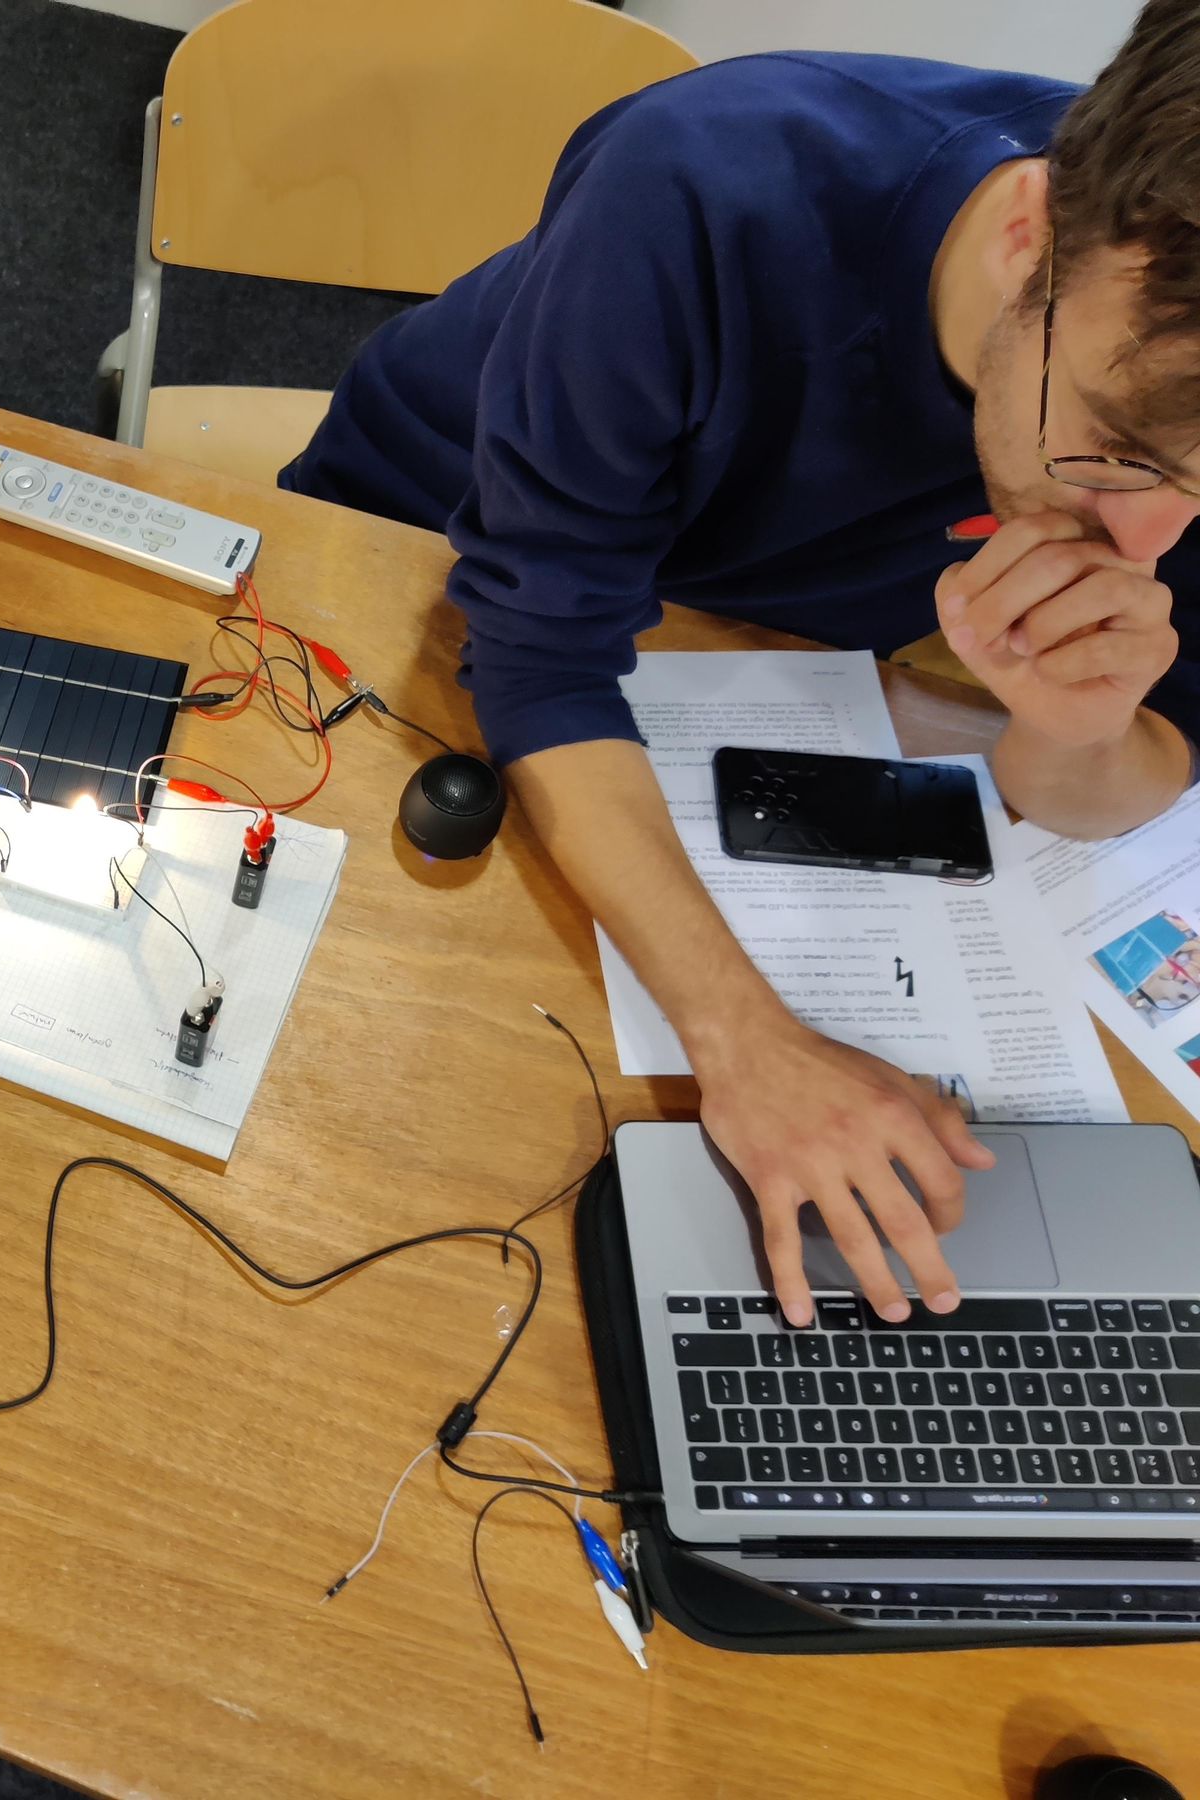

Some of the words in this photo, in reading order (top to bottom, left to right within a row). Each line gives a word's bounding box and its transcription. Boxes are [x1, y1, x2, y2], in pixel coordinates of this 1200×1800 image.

[213, 536, 230, 562] SONY
[883, 1346, 896, 1356] M
[921, 1346, 932, 1356] N
[998, 1346, 1007, 1356] V
[1034, 1346, 1045, 1357] C
[1072, 1347, 1082, 1357] X
[1110, 1346, 1120, 1358] Z
[836, 1382, 845, 1393] L
[873, 1383, 883, 1393] K
[911, 1382, 919, 1393] J
[948, 1384, 959, 1393] H
[986, 1383, 997, 1394] G
[1026, 1384, 1034, 1394] F
[1062, 1383, 1073, 1395] D
[1100, 1383, 1110, 1395] S
[1138, 1384, 1147, 1395] A
[813, 1421, 823, 1431] P
[851, 1420, 862, 1432] O
[927, 1420, 938, 1431] U
[967, 1421, 976, 1432] Y
[1006, 1421, 1015, 1432] T
[1043, 1422, 1053, 1433] R
[1081, 1421, 1091, 1433] E
[1119, 1422, 1131, 1433] W
[1157, 1421, 1168, 1433] Q
[838, 1453, 848, 1464] 0
[877, 1453, 887, 1465] 9
[915, 1453, 925, 1465] 8
[955, 1454, 963, 1465] 7
[992, 1454, 1002, 1465] 6
[1031, 1454, 1041, 1465] 5
[1070, 1455, 1079, 1465] 4
[1109, 1454, 1118, 1466] 3
[1148, 1455, 1157, 1466] 2
[1188, 1456, 1196, 1466] 1
